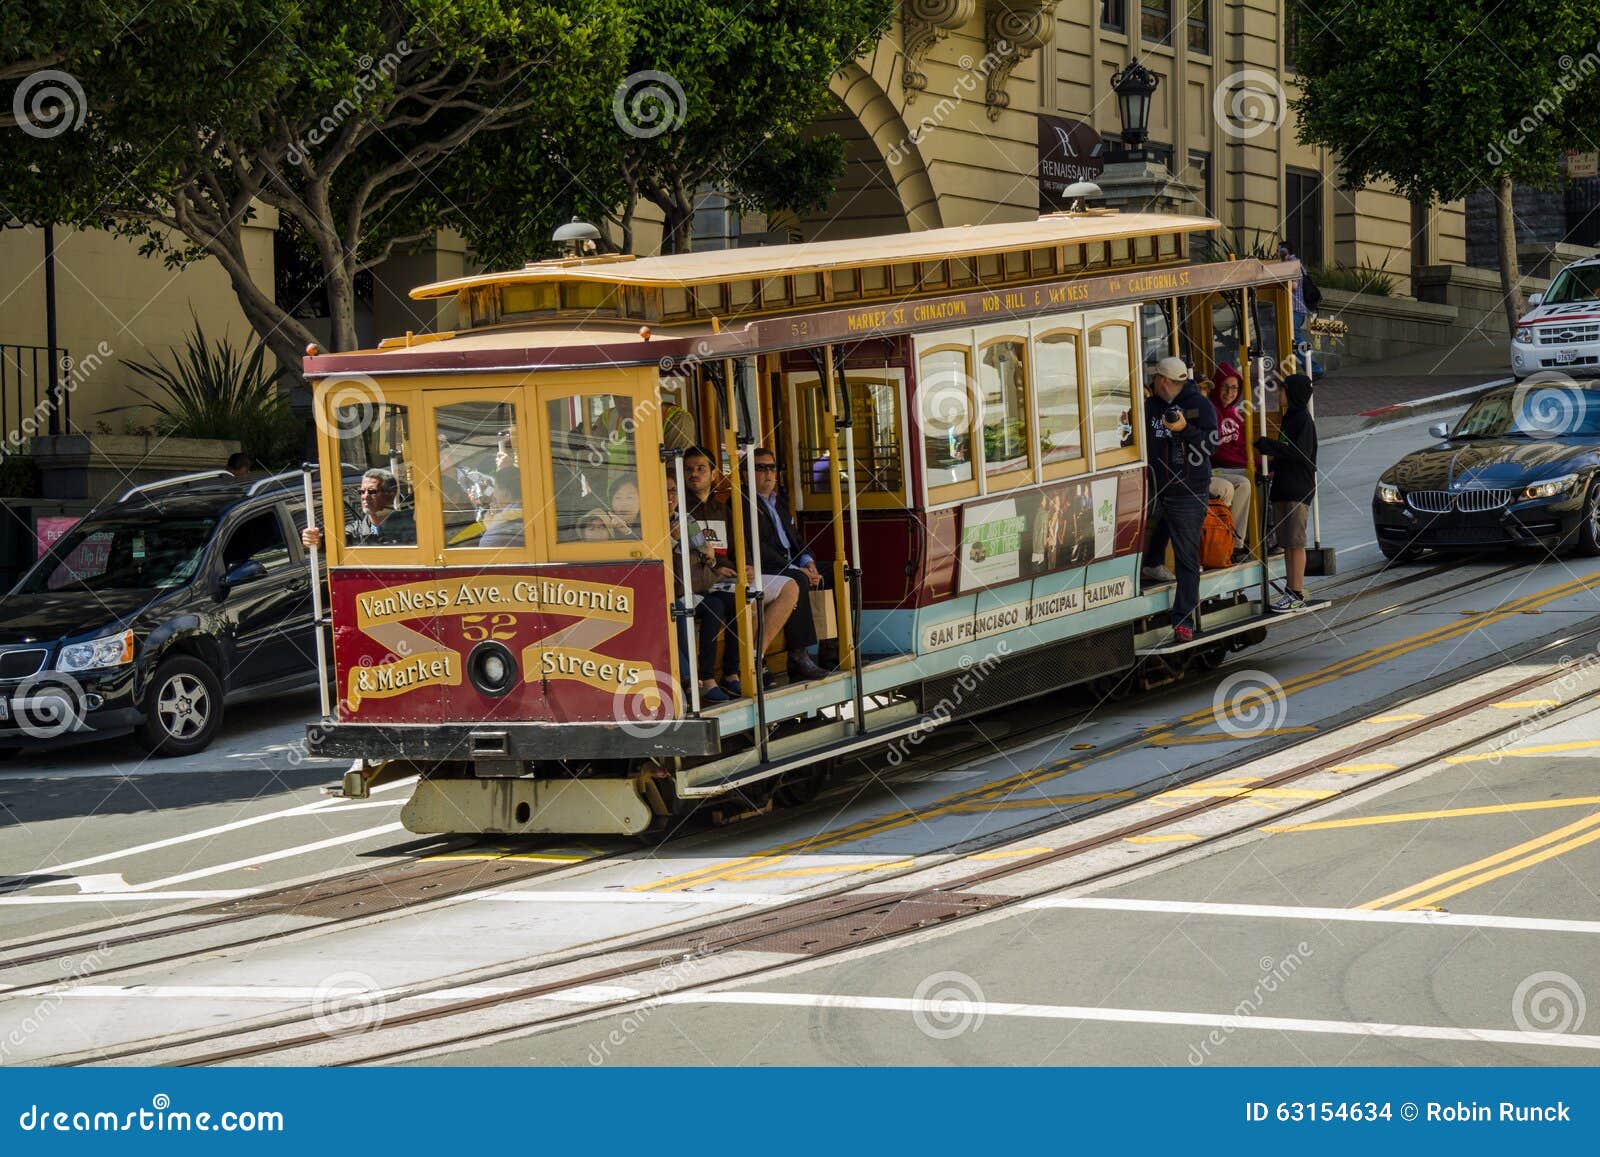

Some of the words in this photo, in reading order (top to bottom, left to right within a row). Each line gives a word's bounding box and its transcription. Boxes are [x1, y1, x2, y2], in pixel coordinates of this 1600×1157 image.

[1042, 160, 1097, 181] RENAISSANCE
[791, 321, 808, 337] 52
[848, 311, 886, 331] MARKET
[913, 301, 967, 321] CHINATOWN
[982, 295, 1000, 312] NOB
[1005, 292, 1025, 309] HILL
[1066, 285, 1089, 300] NESS
[1128, 274, 1178, 293] CALIFORNIA
[512, 581, 630, 614] California
[929, 627, 954, 647] SAN
[957, 607, 1019, 640] FRANCISCO
[1024, 594, 1079, 621] MUNICIPAL
[1084, 581, 1126, 604] RAILWAY
[461, 613, 518, 641] 52
[357, 669, 374, 692] &
[375, 655, 452, 692] Market
[540, 651, 640, 685] Streets
